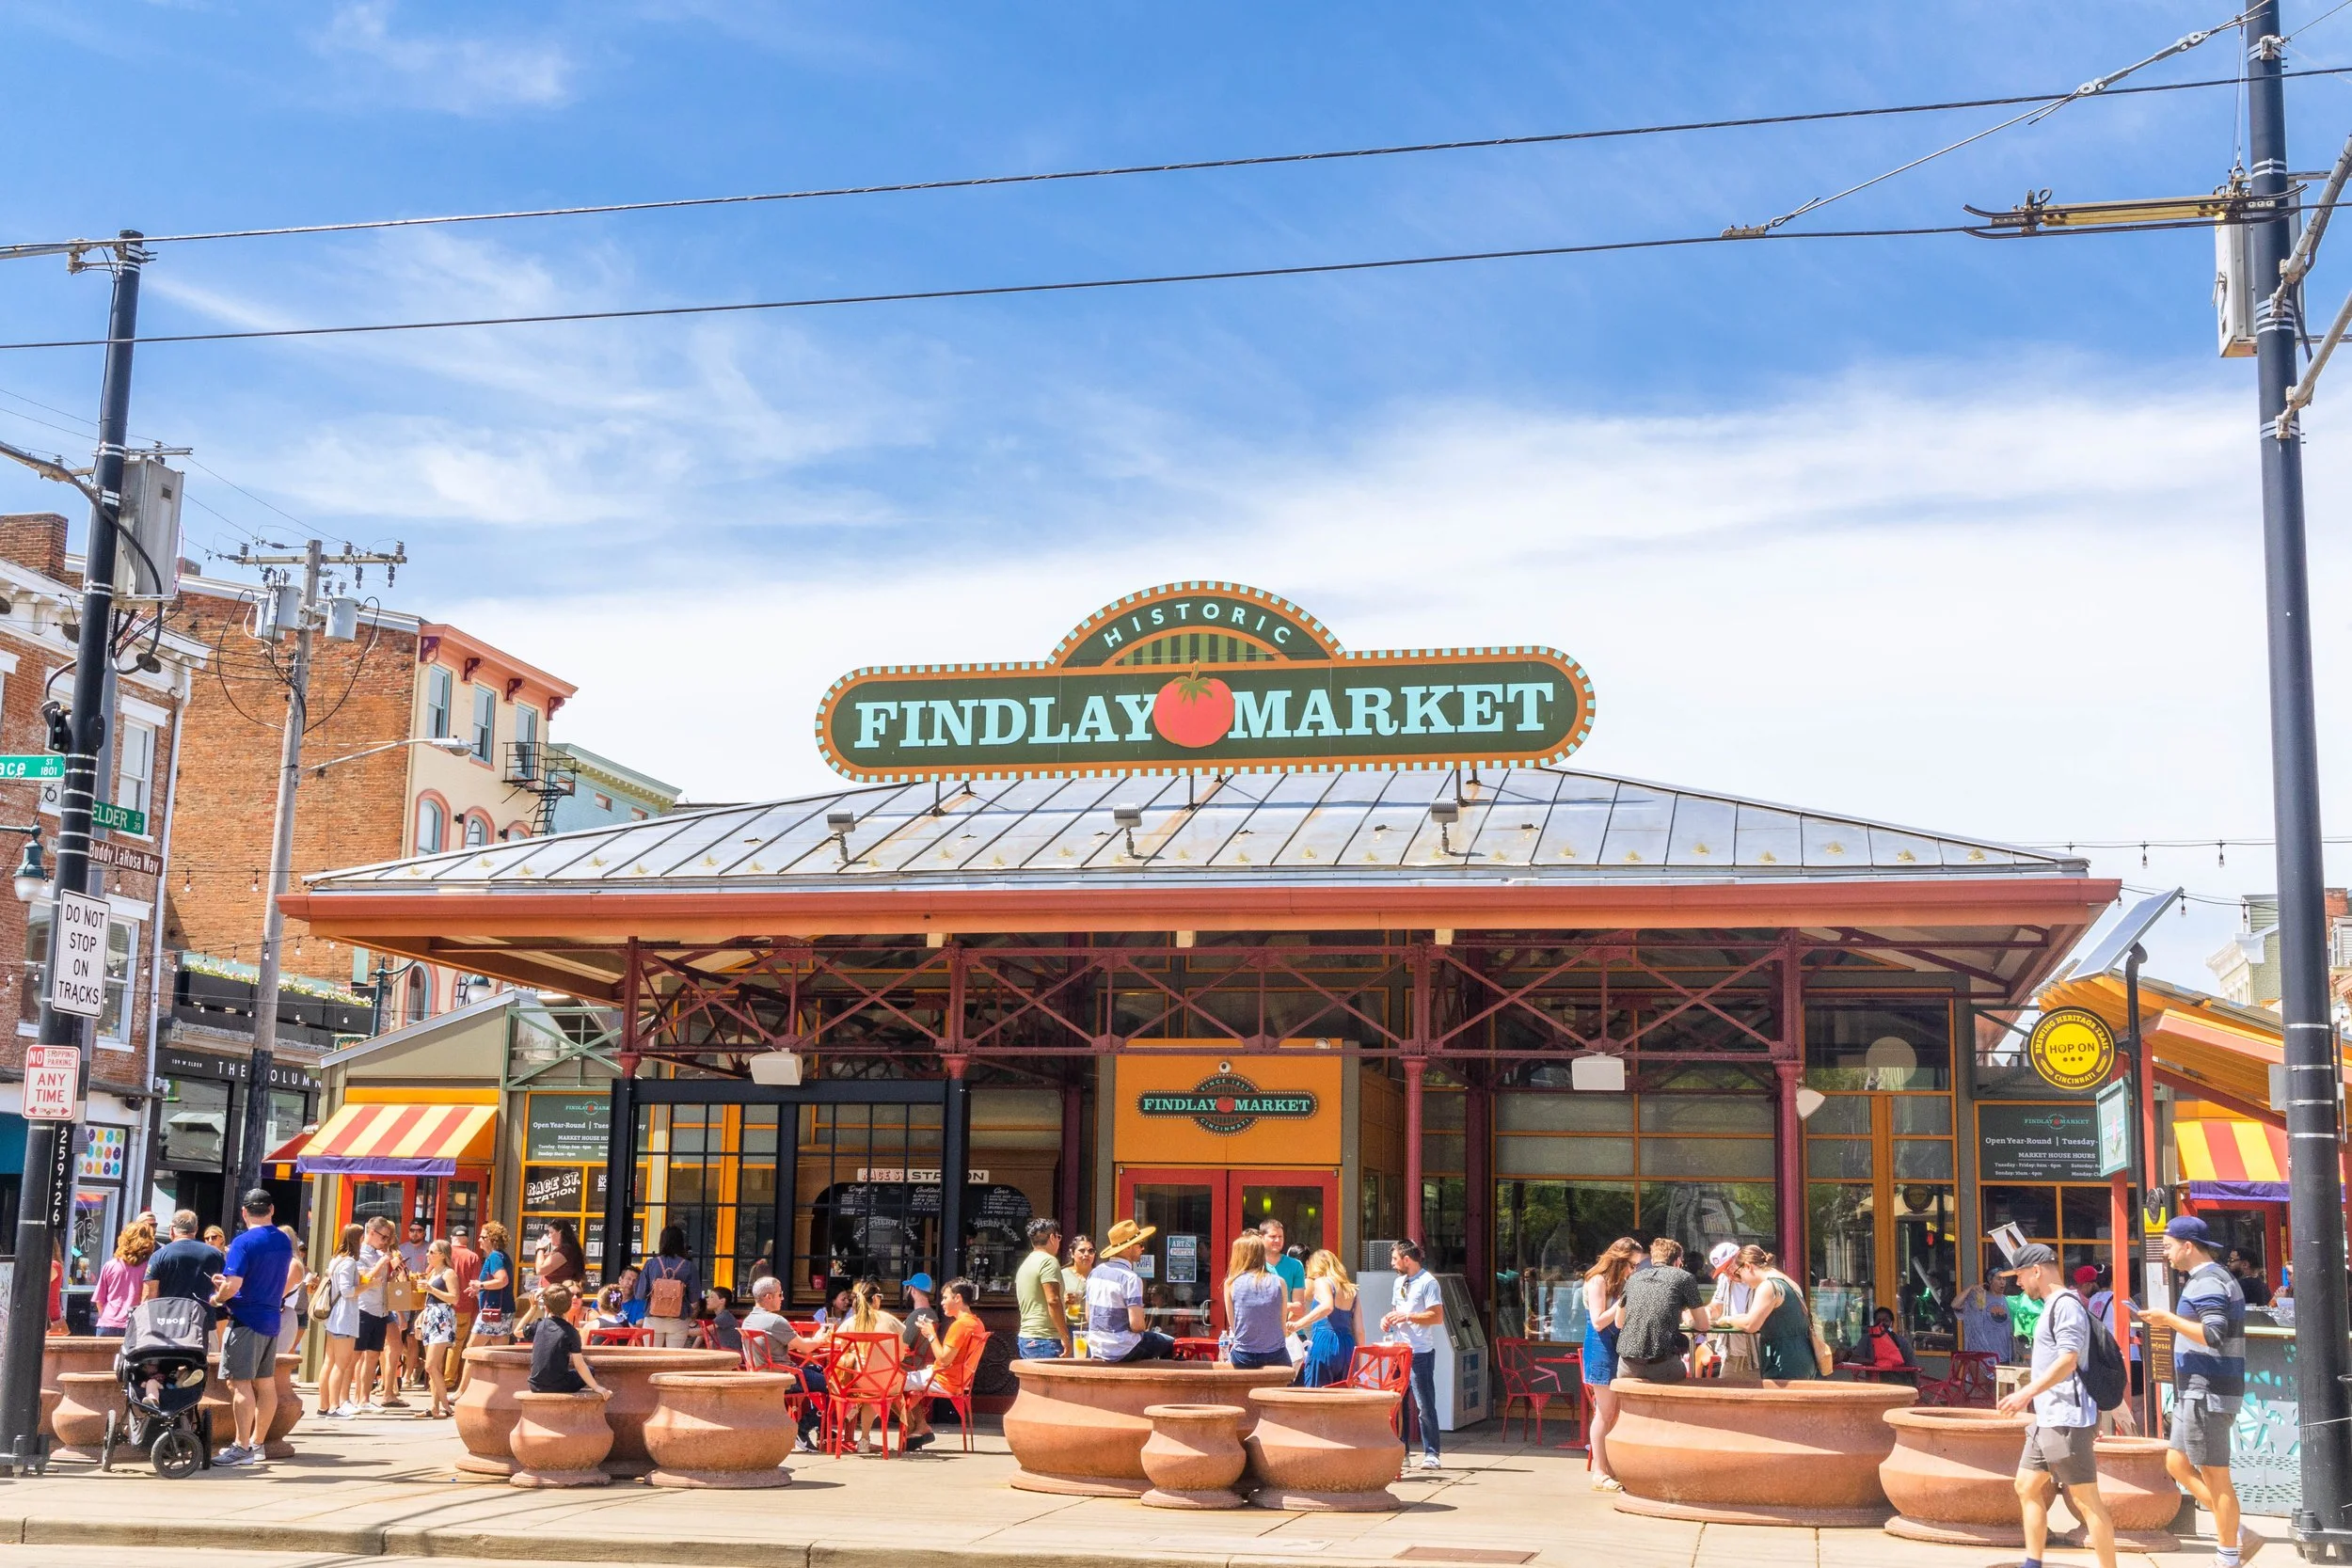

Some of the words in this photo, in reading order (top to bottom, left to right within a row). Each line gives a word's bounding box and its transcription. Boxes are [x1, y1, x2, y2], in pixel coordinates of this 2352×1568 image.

[1103, 602, 1295, 648] HISTORIC
[853, 695, 1155, 750] FINDLAY
[1229, 682, 1555, 739] MARKET
[45, 757, 54, 766] ST
[40, 767, 57, 776] 1801
[92, 804, 128, 829] ELDER
[89, 839, 114, 866] Buddy
[115, 846, 142, 870] LaRosa
[143, 853, 159, 877] Way
[66, 904, 80, 924] DO
[84, 906, 104, 929] NOT
[70, 932, 97, 953] STOP
[73, 959, 89, 977] ON
[58, 980, 99, 1006] TRACKS
[2035, 1020, 2057, 1054] BREWING
[2056, 1015, 2097, 1030] HERITAGE
[2094, 1027, 2109, 1051] TRAIL
[2049, 1043, 2075, 1054] HOP
[2077, 1042, 2095, 1053] ON
[29, 1050, 44, 1065] NO
[46, 1050, 75, 1059] STOPPING
[47, 1058, 72, 1067] PARKING
[37, 1072, 67, 1086] ANY
[217, 1061, 246, 1078] THE
[270, 1069, 322, 1088] OLUMN
[2054, 1071, 2096, 1085] CINCINNATI
[1200, 1078, 1227, 1092] SINCE
[1232, 1079, 1250, 1092] 1852
[35, 1088, 66, 1103] TIME
[1143, 1098, 1218, 1111] FINDLAY
[1233, 1099, 1311, 1112] MARKET
[532, 1121, 549, 1130] Open
[1200, 1117, 1250, 1132] CINCINNATI
[1985, 1137, 2006, 1146] Open
[527, 1176, 560, 1196] RACE
[562, 1171, 581, 1186] ST.
[527, 1187, 577, 1205] STATION
